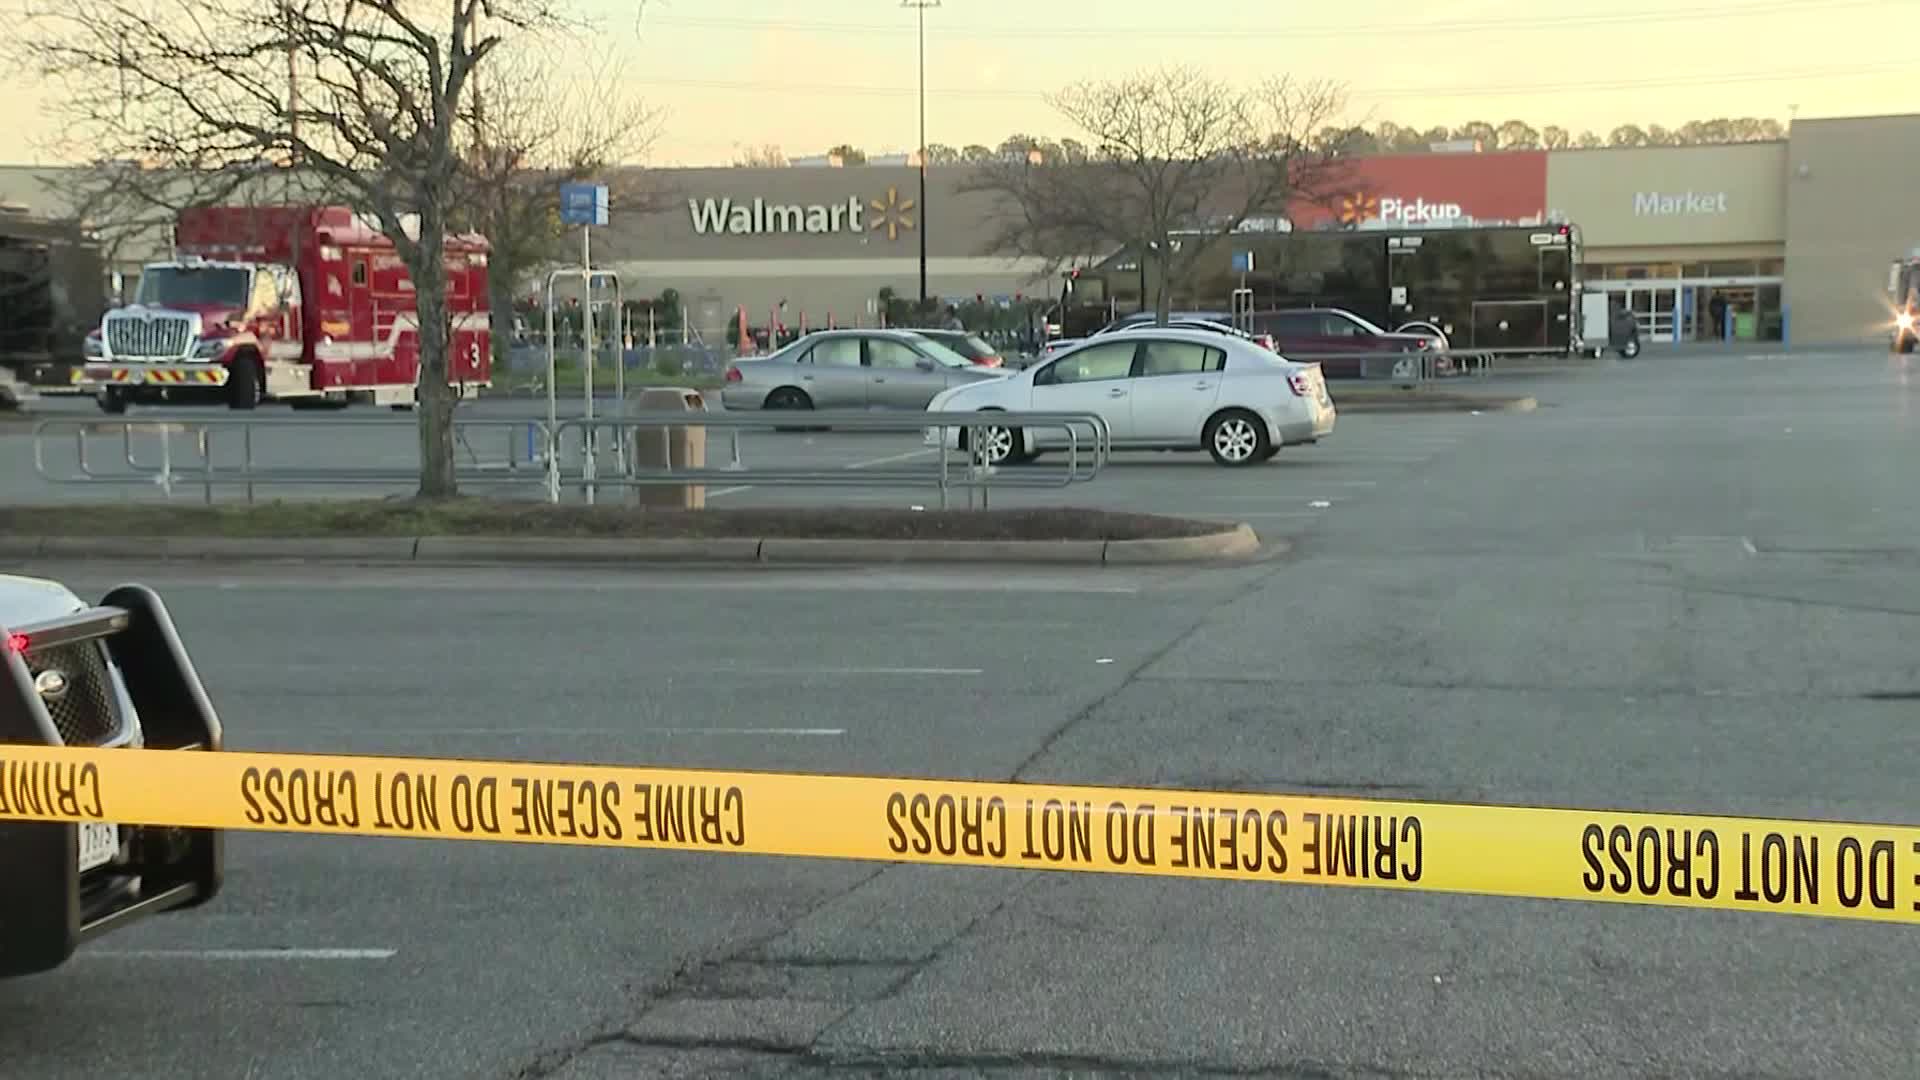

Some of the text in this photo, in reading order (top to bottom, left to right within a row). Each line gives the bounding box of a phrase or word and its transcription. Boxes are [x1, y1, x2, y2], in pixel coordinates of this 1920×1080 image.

[689, 196, 863, 234] Walmart
[1381, 197, 1461, 221] Pickup
[1633, 191, 1728, 216] Market
[471, 343, 480, 368] 3
[242, 768, 744, 846] CRIME SCENE DO NOT CROSS
[887, 793, 1422, 882] CRIME SCENE DO NOT CROSS
[1582, 824, 1719, 899] CROSS
[1734, 833, 1818, 904] NOT
[1837, 837, 1895, 910] DO
